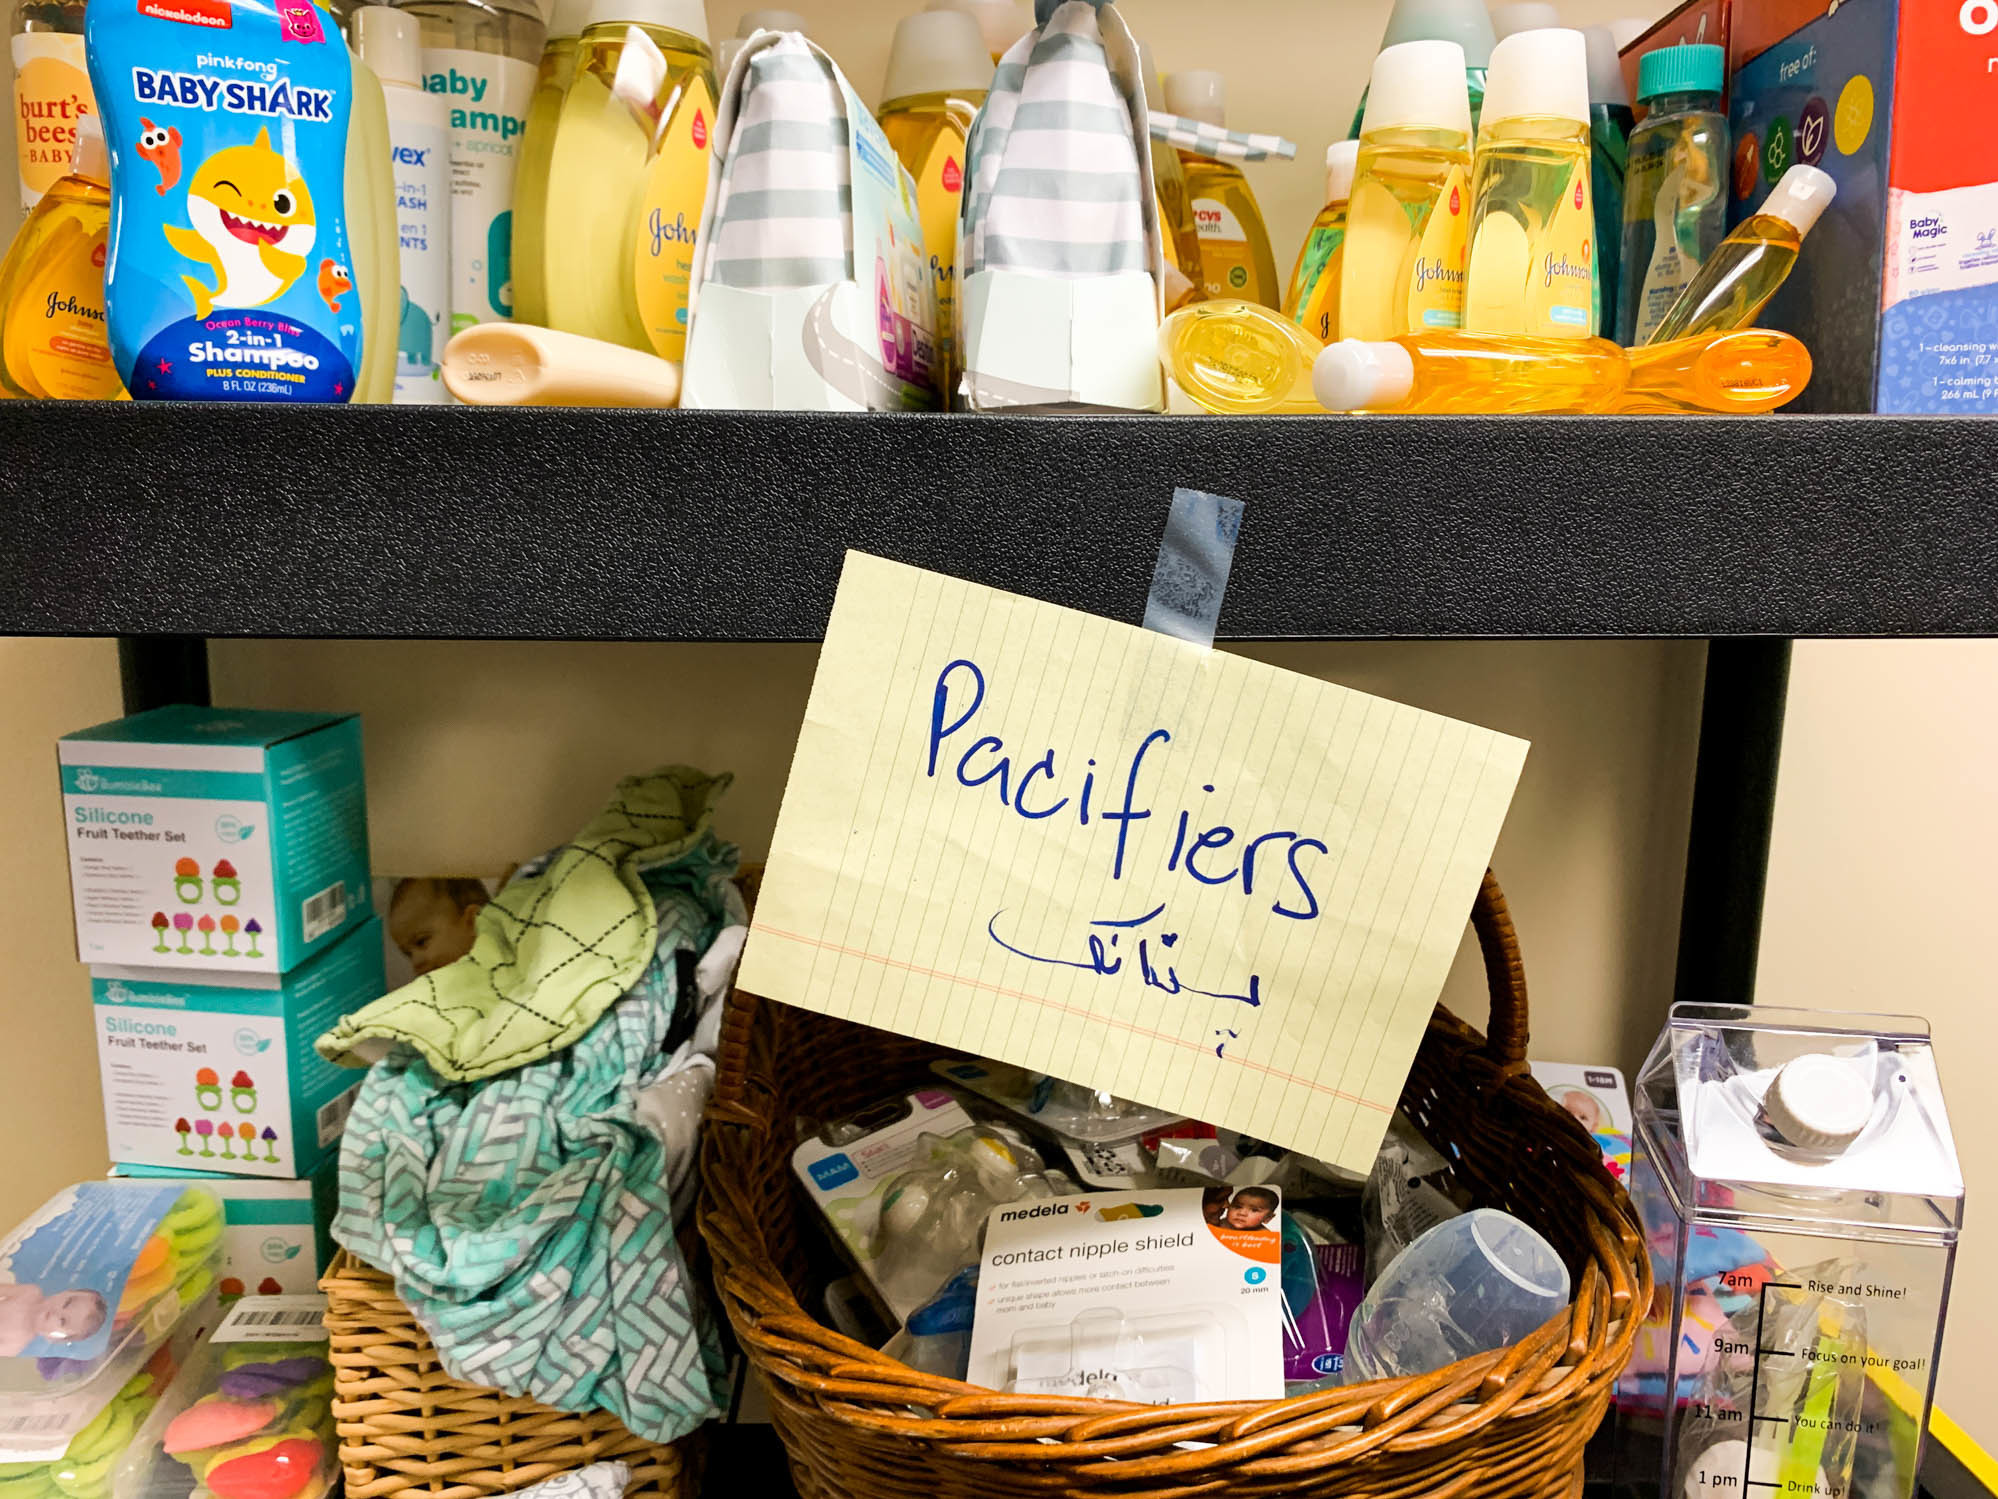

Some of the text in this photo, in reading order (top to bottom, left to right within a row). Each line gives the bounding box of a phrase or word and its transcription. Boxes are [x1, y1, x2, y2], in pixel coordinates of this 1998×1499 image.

[145, 5, 226, 26] nickelodeon
[196, 53, 278, 81] pinkfong
[1779, 45, 1817, 82] free of:
[423, 68, 488, 102] aby
[135, 70, 330, 119] BABY SHARK
[20, 93, 88, 119] burt's
[397, 196, 428, 211] ASH
[1910, 217, 1939, 230] Baby
[1913, 224, 1948, 239] Magic
[400, 236, 428, 250] NTS
[206, 318, 241, 331] Ocean
[244, 317, 274, 331] Berry
[226, 330, 282, 347] 2-in-1
[188, 341, 320, 370] Shampoo
[206, 369, 306, 384] PLUS CONDITIONER
[244, 381, 256, 392] OZ
[927, 659, 1328, 920] Pacifiers
[74, 806, 154, 826] Silicone
[77, 827, 187, 843] Fruit Teether Set
[105, 1016, 177, 1037] Silicone
[108, 1035, 208, 1054] Fruit Teether Set
[1000, 1203, 1069, 1223] medela
[992, 1231, 1194, 1267] contact nipple shield
[1079, 1286, 1100, 1294] more
[1102, 1281, 1132, 1292] contact
[1135, 1278, 1170, 1289] between
[1718, 1271, 1753, 1287] 7am
[1241, 1286, 1269, 1295] 20 mm
[1808, 1280, 1907, 1299] Rise and Shine!
[1018, 1303, 1033, 1312] and
[1036, 1301, 1056, 1311] baby
[1714, 1338, 1749, 1355] 9am
[1801, 1348, 1926, 1371] Focus on your goal!
[1694, 1404, 1743, 1421] 11 am
[1794, 1415, 1880, 1434] You can do it!
[1699, 1470, 1737, 1488] 1 pm
[1788, 1480, 1845, 1498] Drink up!
